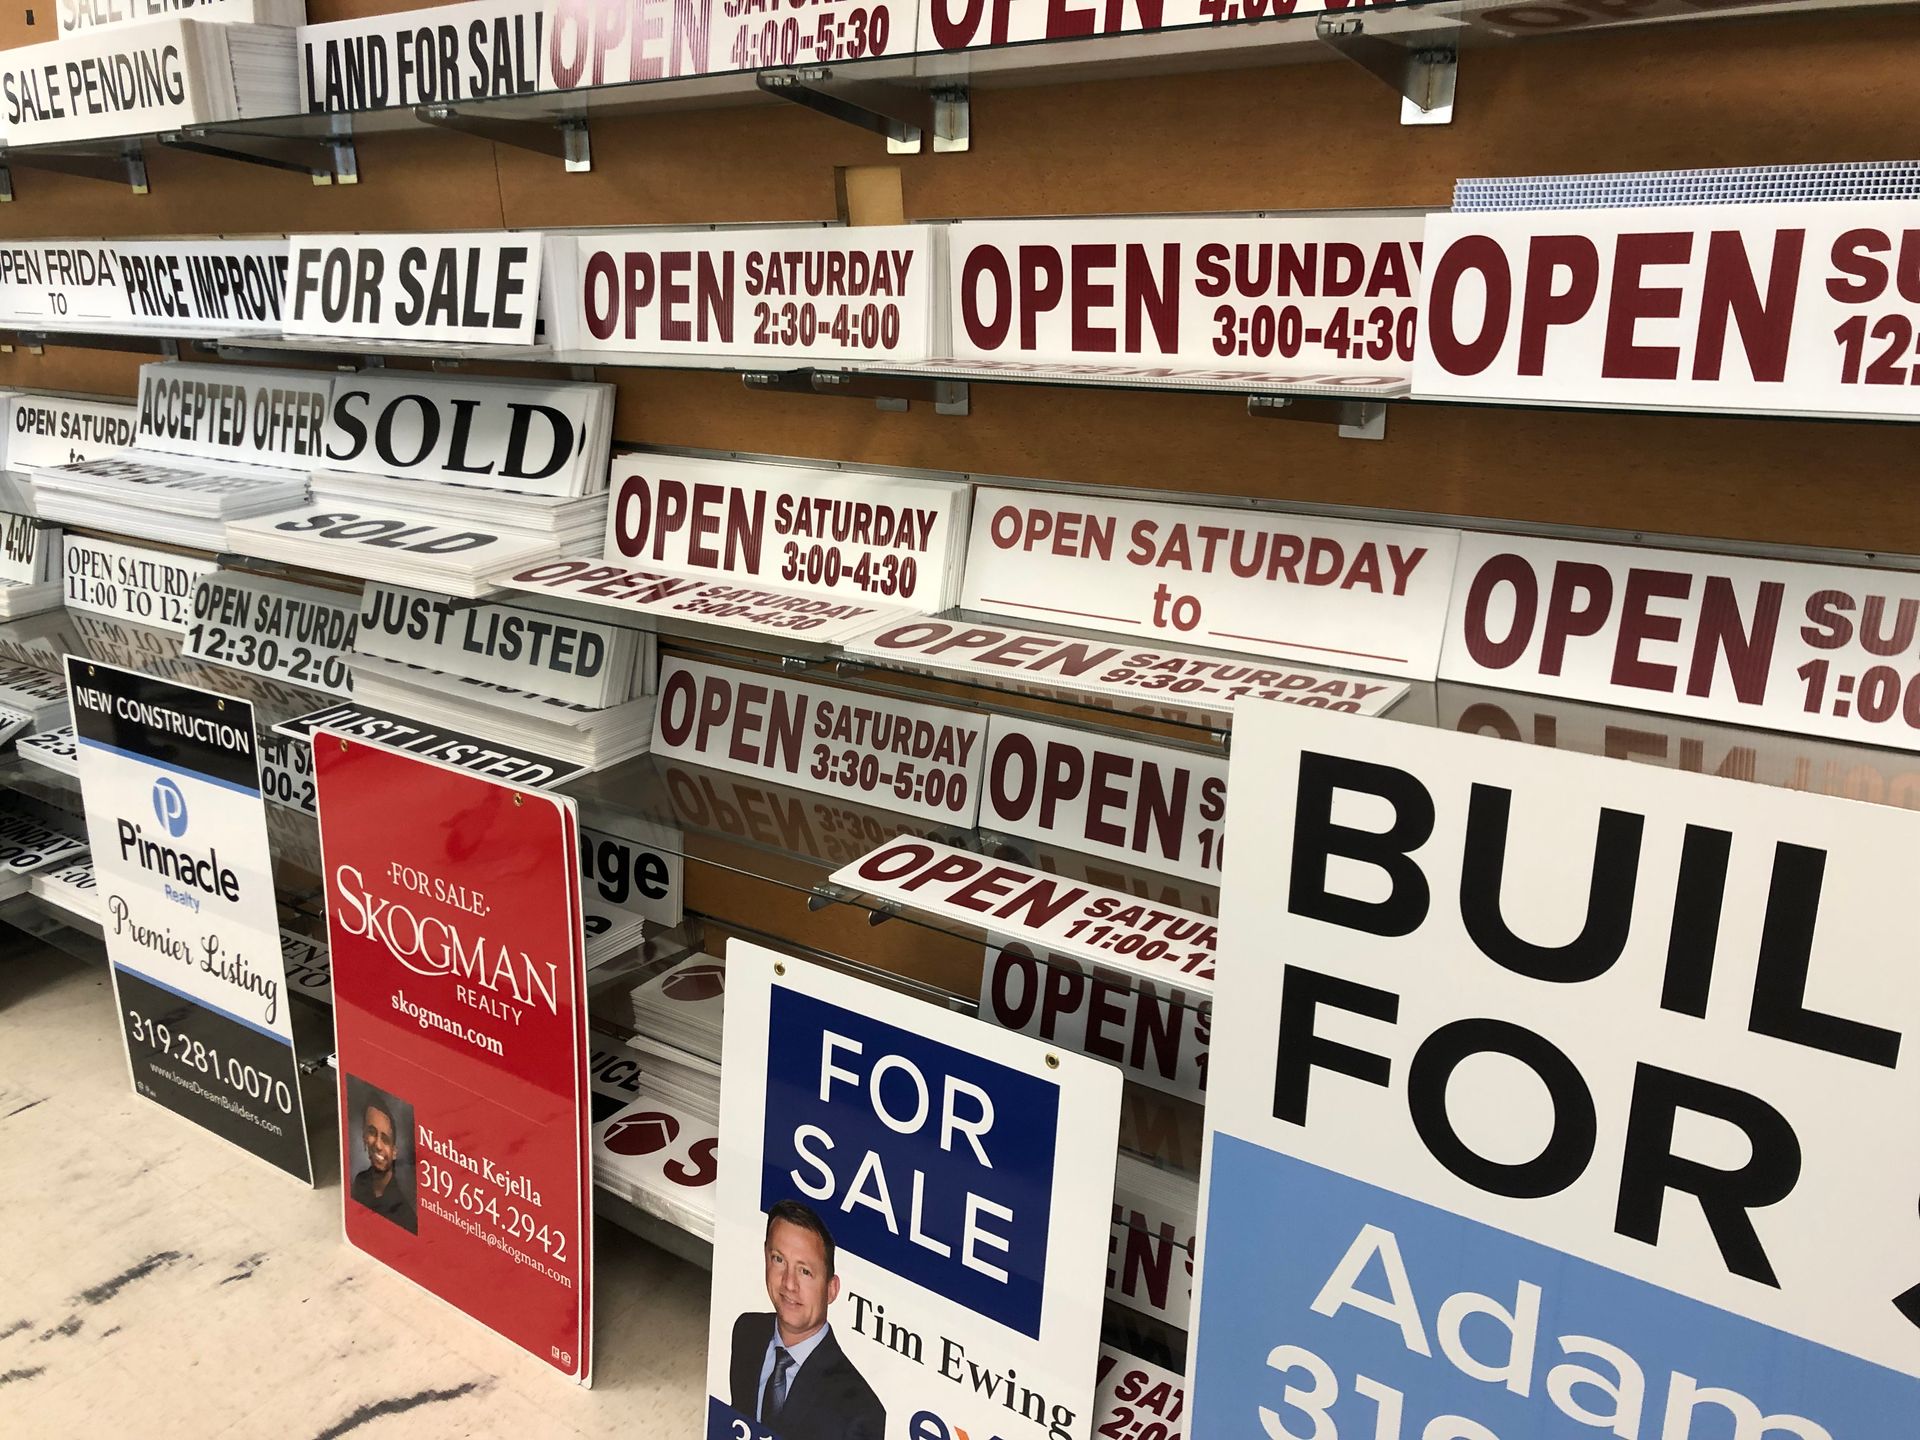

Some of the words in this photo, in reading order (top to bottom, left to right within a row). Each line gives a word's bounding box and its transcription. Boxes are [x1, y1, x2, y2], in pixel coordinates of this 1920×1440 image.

[305, 34, 389, 112] LAND
[396, 25, 460, 104] FOR
[468, 11, 544, 98] SAL
[549, 0, 713, 90] OPEN
[731, 4, 890, 69] 4:00-5:30
[3, 66, 66, 125] SALE
[66, 44, 186, 117] PENDING
[0, 249, 42, 285] PEN
[48, 292, 68, 315] TO
[120, 255, 191, 319] PRICE
[292, 248, 385, 325] FOR
[394, 246, 528, 329] SALE
[584, 250, 735, 343] OPEN
[745, 249, 914, 297] SATURDAY
[961, 243, 1181, 354] OPEN
[1428, 228, 1806, 383] OPEN
[753, 301, 901, 350] 2:30-4:00
[1212, 304, 1418, 362] 3:00-4:30
[16, 406, 56, 437] OPEN
[139, 376, 247, 447] ACCEPTED
[253, 387, 325, 457] OFFER
[326, 390, 574, 480] SOLD
[68, 546, 113, 581] OPEN
[274, 512, 499, 555] SOLD
[615, 474, 766, 576] OPEN
[774, 493, 939, 553] SATURDAY
[990, 504, 1117, 561] OPEN
[1126, 518, 1428, 597] SATURDAY
[69, 575, 117, 609] 11:00
[124, 588, 151, 617] TO
[511, 561, 706, 604] OPEN
[706, 585, 877, 621] SATURDAY
[781, 541, 918, 599] 3:00-4:30
[1152, 582, 1202, 632] to
[194, 582, 252, 629] OPEN
[254, 594, 359, 653] SATURDA
[361, 590, 456, 645] JUST
[462, 609, 605, 678] LISTED
[672, 599, 829, 631] 3:00-4:30
[1464, 552, 1786, 706] OPEN
[1800, 589, 1920, 657] SU
[873, 621, 1118, 678] OPEN
[1121, 652, 1389, 702] SATURDAY
[76, 685, 112, 715] NEW
[116, 696, 250, 755] CONSTRUCTION
[660, 669, 808, 774] OPEN
[813, 699, 978, 768] SATURDAY
[810, 742, 968, 813] 3:30-5:00
[989, 731, 1191, 862] OPEN
[117, 817, 240, 903] Pinnacle
[858, 842, 1090, 930] OPEN
[1197, 827, 1224, 873] 1
[164, 883, 200, 914] Realty
[336, 864, 558, 1016] SKOGMAN
[1287, 749, 1903, 1071] BUIL
[108, 894, 194, 966] Premier
[200, 934, 278, 1025] Listing
[391, 989, 505, 1057] skogman.com
[456, 984, 523, 1026] REALTY
[990, 940, 1187, 1082] OPEN
[130, 1010, 292, 1114] 319.281.0070
[819, 1028, 995, 1170] FOR
[418, 1124, 479, 1176] Nathan
[482, 1157, 542, 1208] Kejella
[1272, 963, 1803, 1291] FOR
[420, 1158, 567, 1264] 319.654.2942
[421, 1197, 573, 1289] nathankejella@skogman.com
[789, 1122, 1015, 1286] SALE
[846, 1290, 926, 1367] Tim
[937, 1335, 1077, 1440] Ewing
[1309, 1222, 1836, 1440] Adam
[1098, 1406, 1181, 1440] 2:0
[1258, 1343, 1500, 1440] 31
